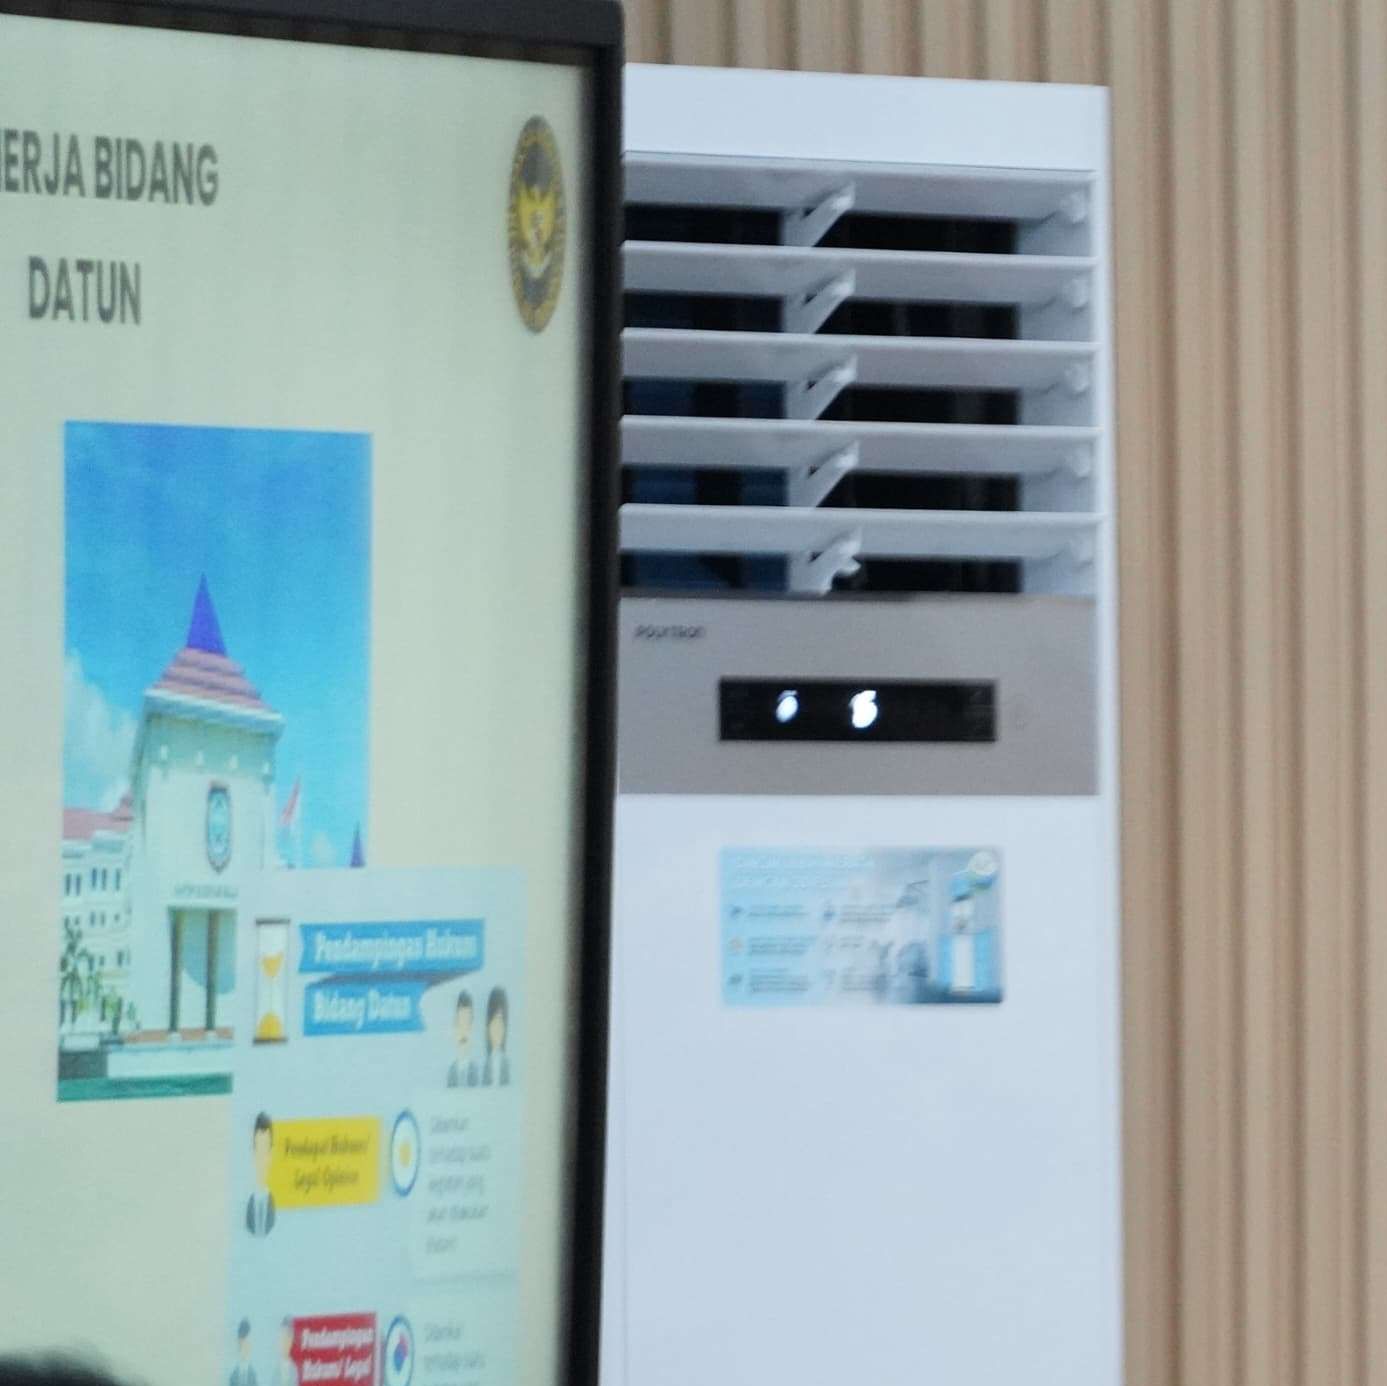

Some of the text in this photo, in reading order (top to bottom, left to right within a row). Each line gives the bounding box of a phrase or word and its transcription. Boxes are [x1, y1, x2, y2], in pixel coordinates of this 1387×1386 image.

[0, 128, 219, 206] ERJA BIDANG
[28, 256, 141, 326] DATUN
